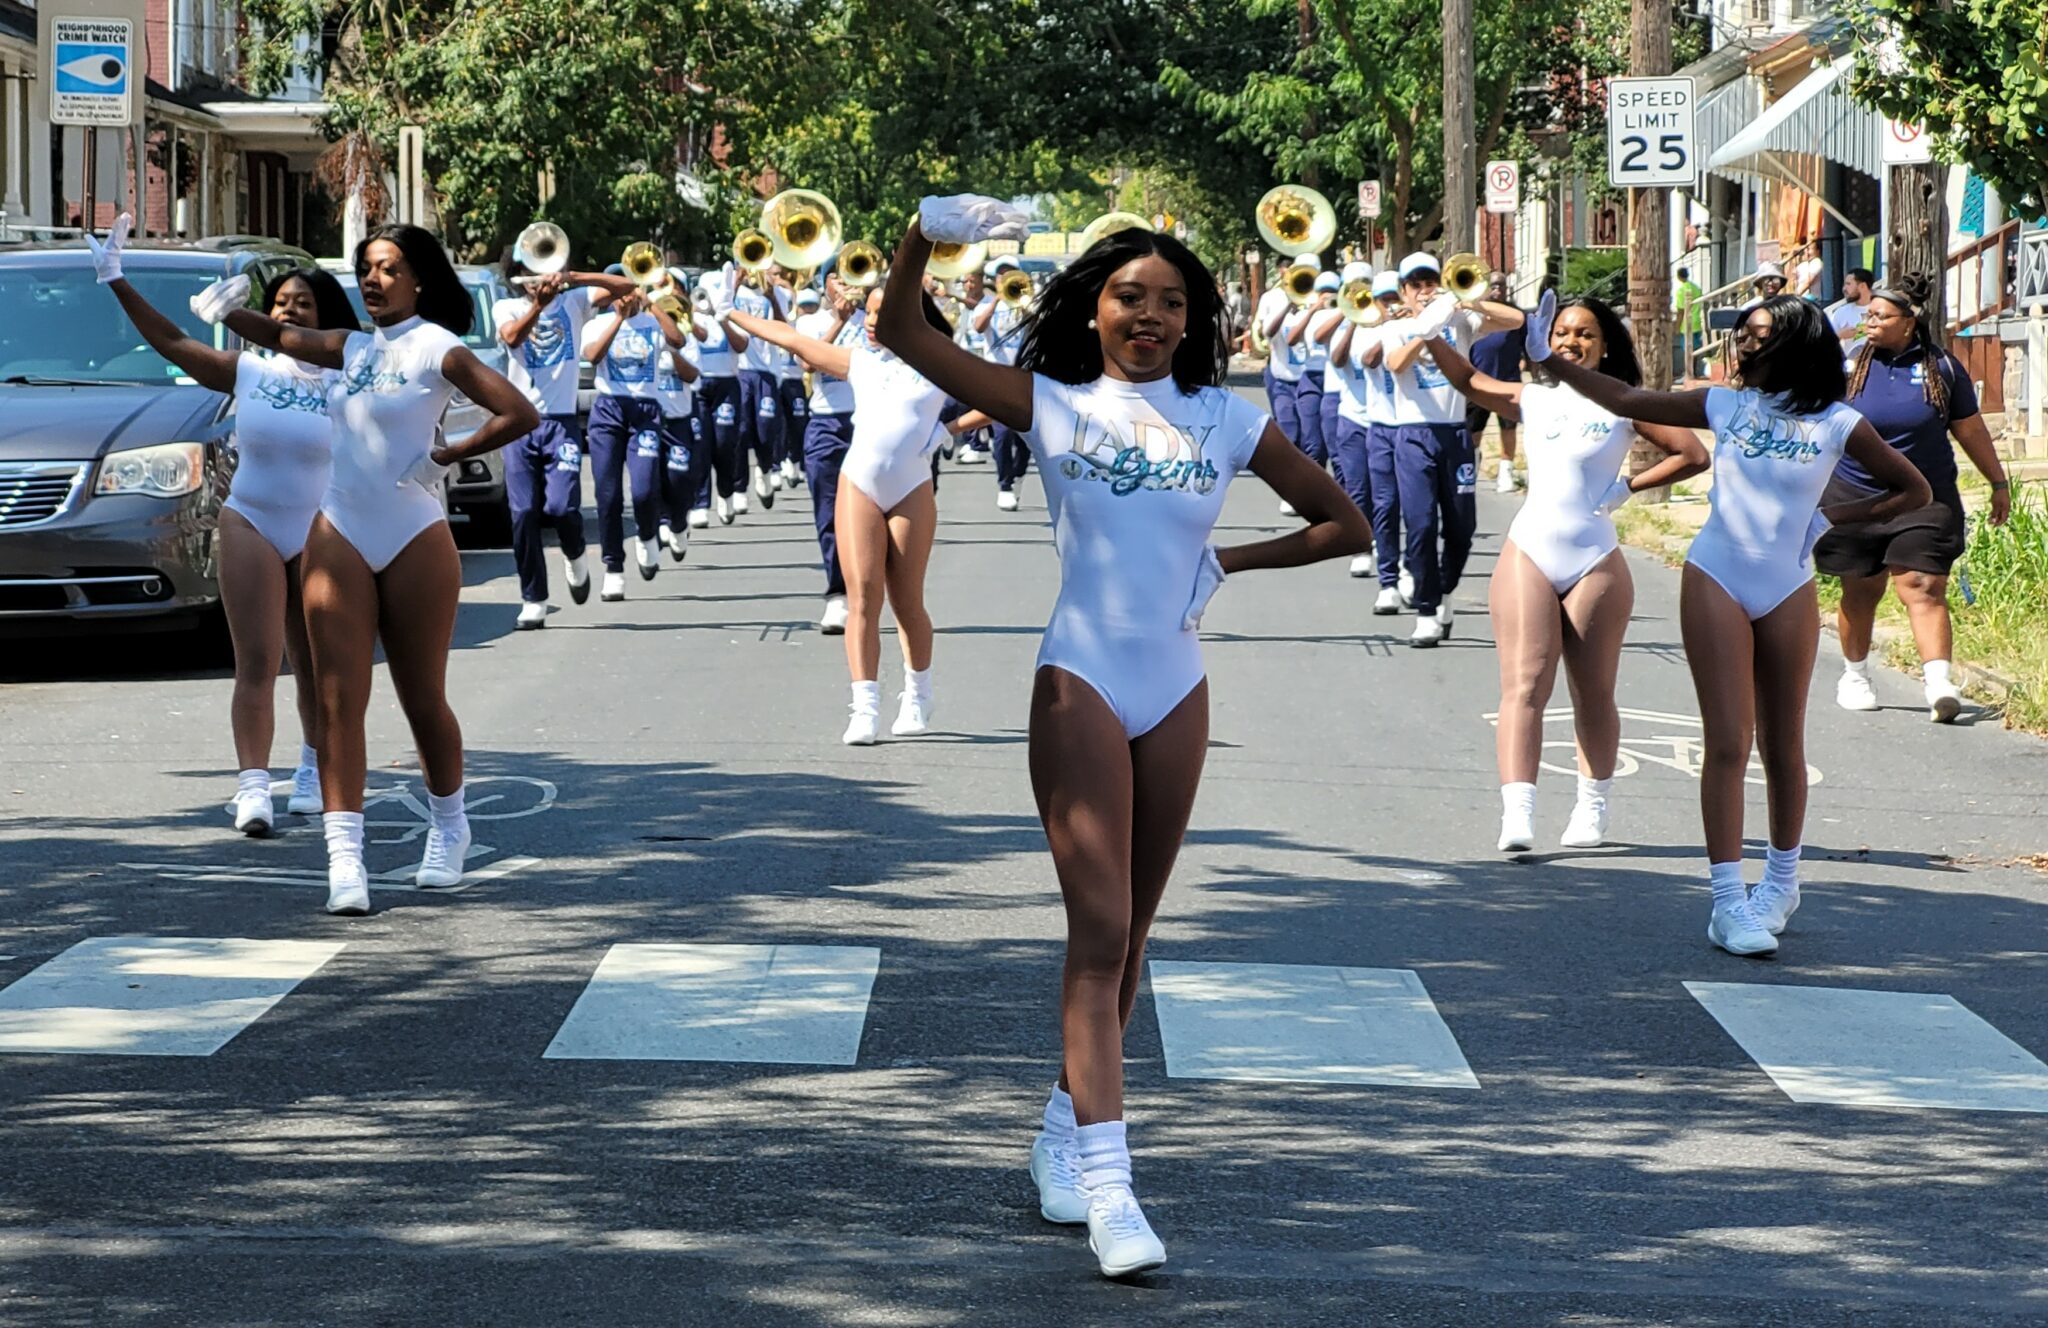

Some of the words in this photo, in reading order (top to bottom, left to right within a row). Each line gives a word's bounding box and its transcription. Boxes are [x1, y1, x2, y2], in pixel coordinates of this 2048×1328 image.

[57, 23, 127, 33] NEIGHBORHOOD
[58, 32, 88, 42] CRIME
[91, 33, 126, 43] WATCH
[1617, 91, 1687, 108] SPEED
[1625, 112, 1679, 128] LIMIT
[1620, 134, 1686, 172] 25
[1069, 411, 1217, 471] LADY
